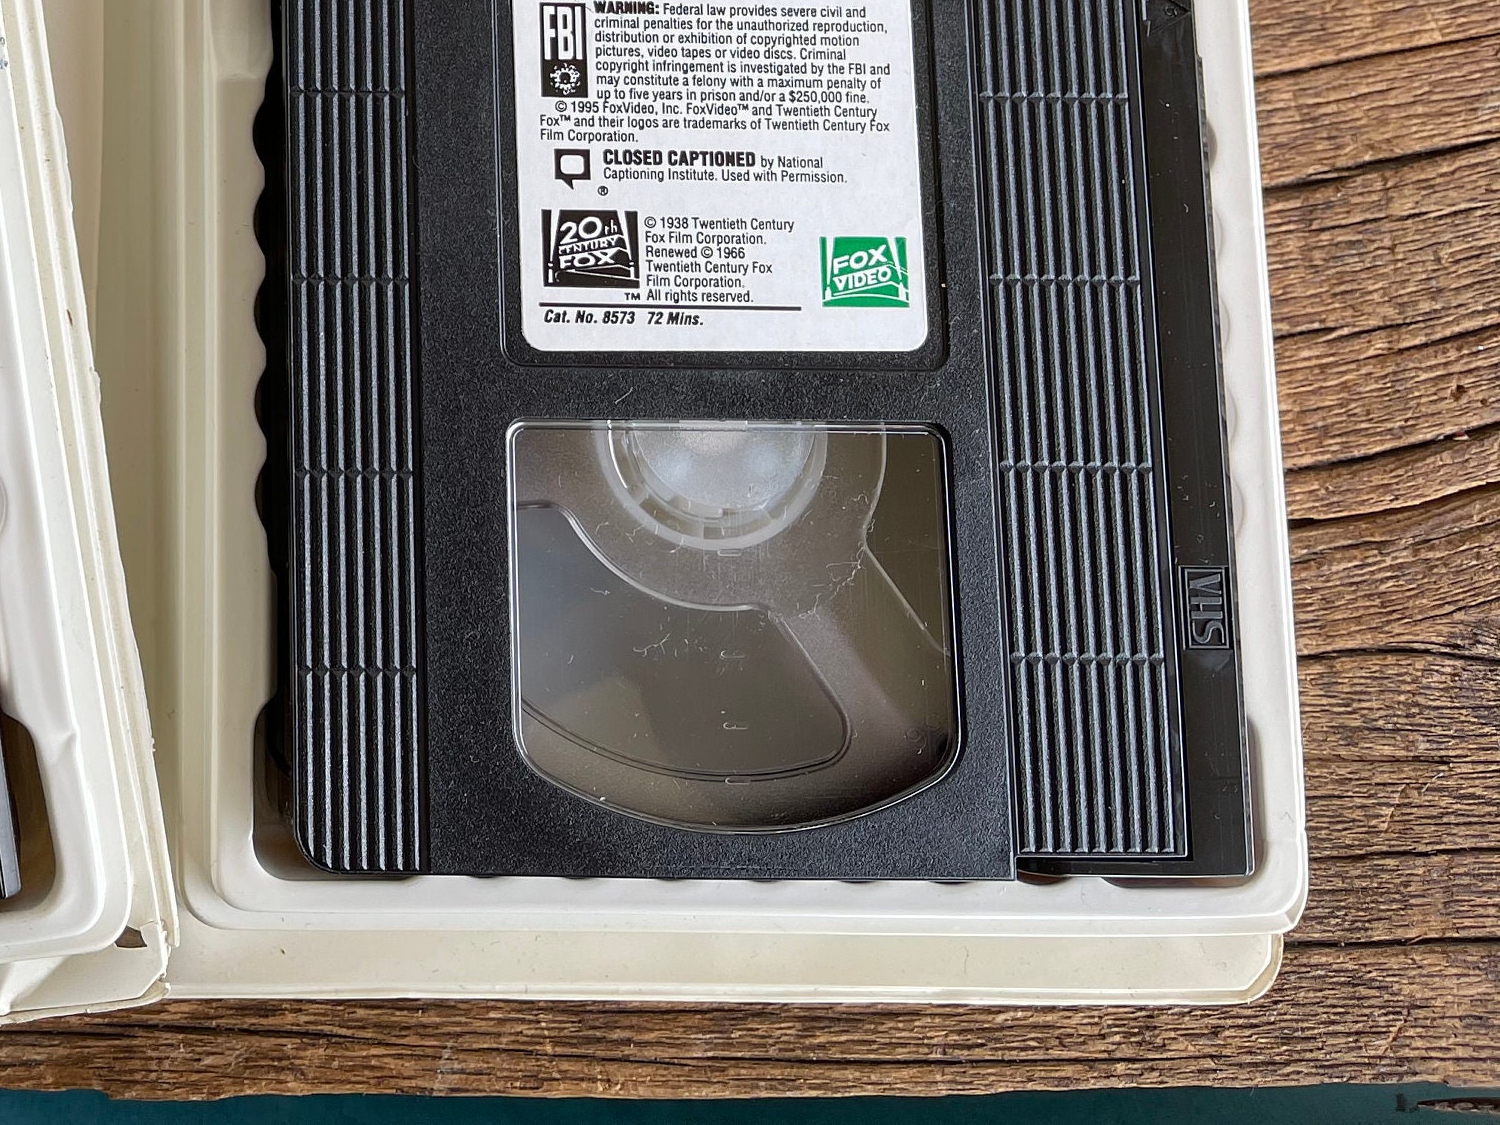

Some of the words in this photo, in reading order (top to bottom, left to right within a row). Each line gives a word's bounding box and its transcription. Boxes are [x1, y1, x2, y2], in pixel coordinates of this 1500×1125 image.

[543, 5, 582, 60] FBI
[603, 149, 662, 165] CLOSED
[667, 150, 755, 167] CAPTIONED
[760, 155, 773, 170] by
[777, 155, 822, 168] National
[603, 166, 664, 182] Captioning
[668, 167, 717, 181] Institute.
[721, 169, 749, 181] Used
[753, 170, 777, 181] with
[781, 169, 847, 182] Permission.
[660, 216, 688, 229] 1938
[691, 217, 746, 229] Twentieth
[750, 217, 794, 232] Century
[645, 230, 665, 243] Fox
[668, 231, 692, 243] Film
[696, 231, 766, 246] Corporation.
[558, 249, 618, 269] FOX
[645, 245, 697, 258] Renewed
[716, 246, 745, 258] 1966
[833, 244, 888, 274] FOX
[645, 259, 701, 272] Twentieth
[704, 260, 748, 275] Century
[752, 261, 772, 273] Fox
[646, 274, 670, 286] Film
[673, 274, 743, 289] Corporation.
[832, 266, 891, 291] VIDEO
[646, 288, 660, 300] All
[665, 289, 697, 303] rights
[701, 290, 753, 302] reserved.
[544, 309, 570, 323] Cat.
[575, 310, 597, 323] No.
[602, 310, 635, 324] 8573
[647, 311, 663, 324] 72
[666, 311, 703, 325] Mins.
[1189, 573, 1225, 644] VHS
